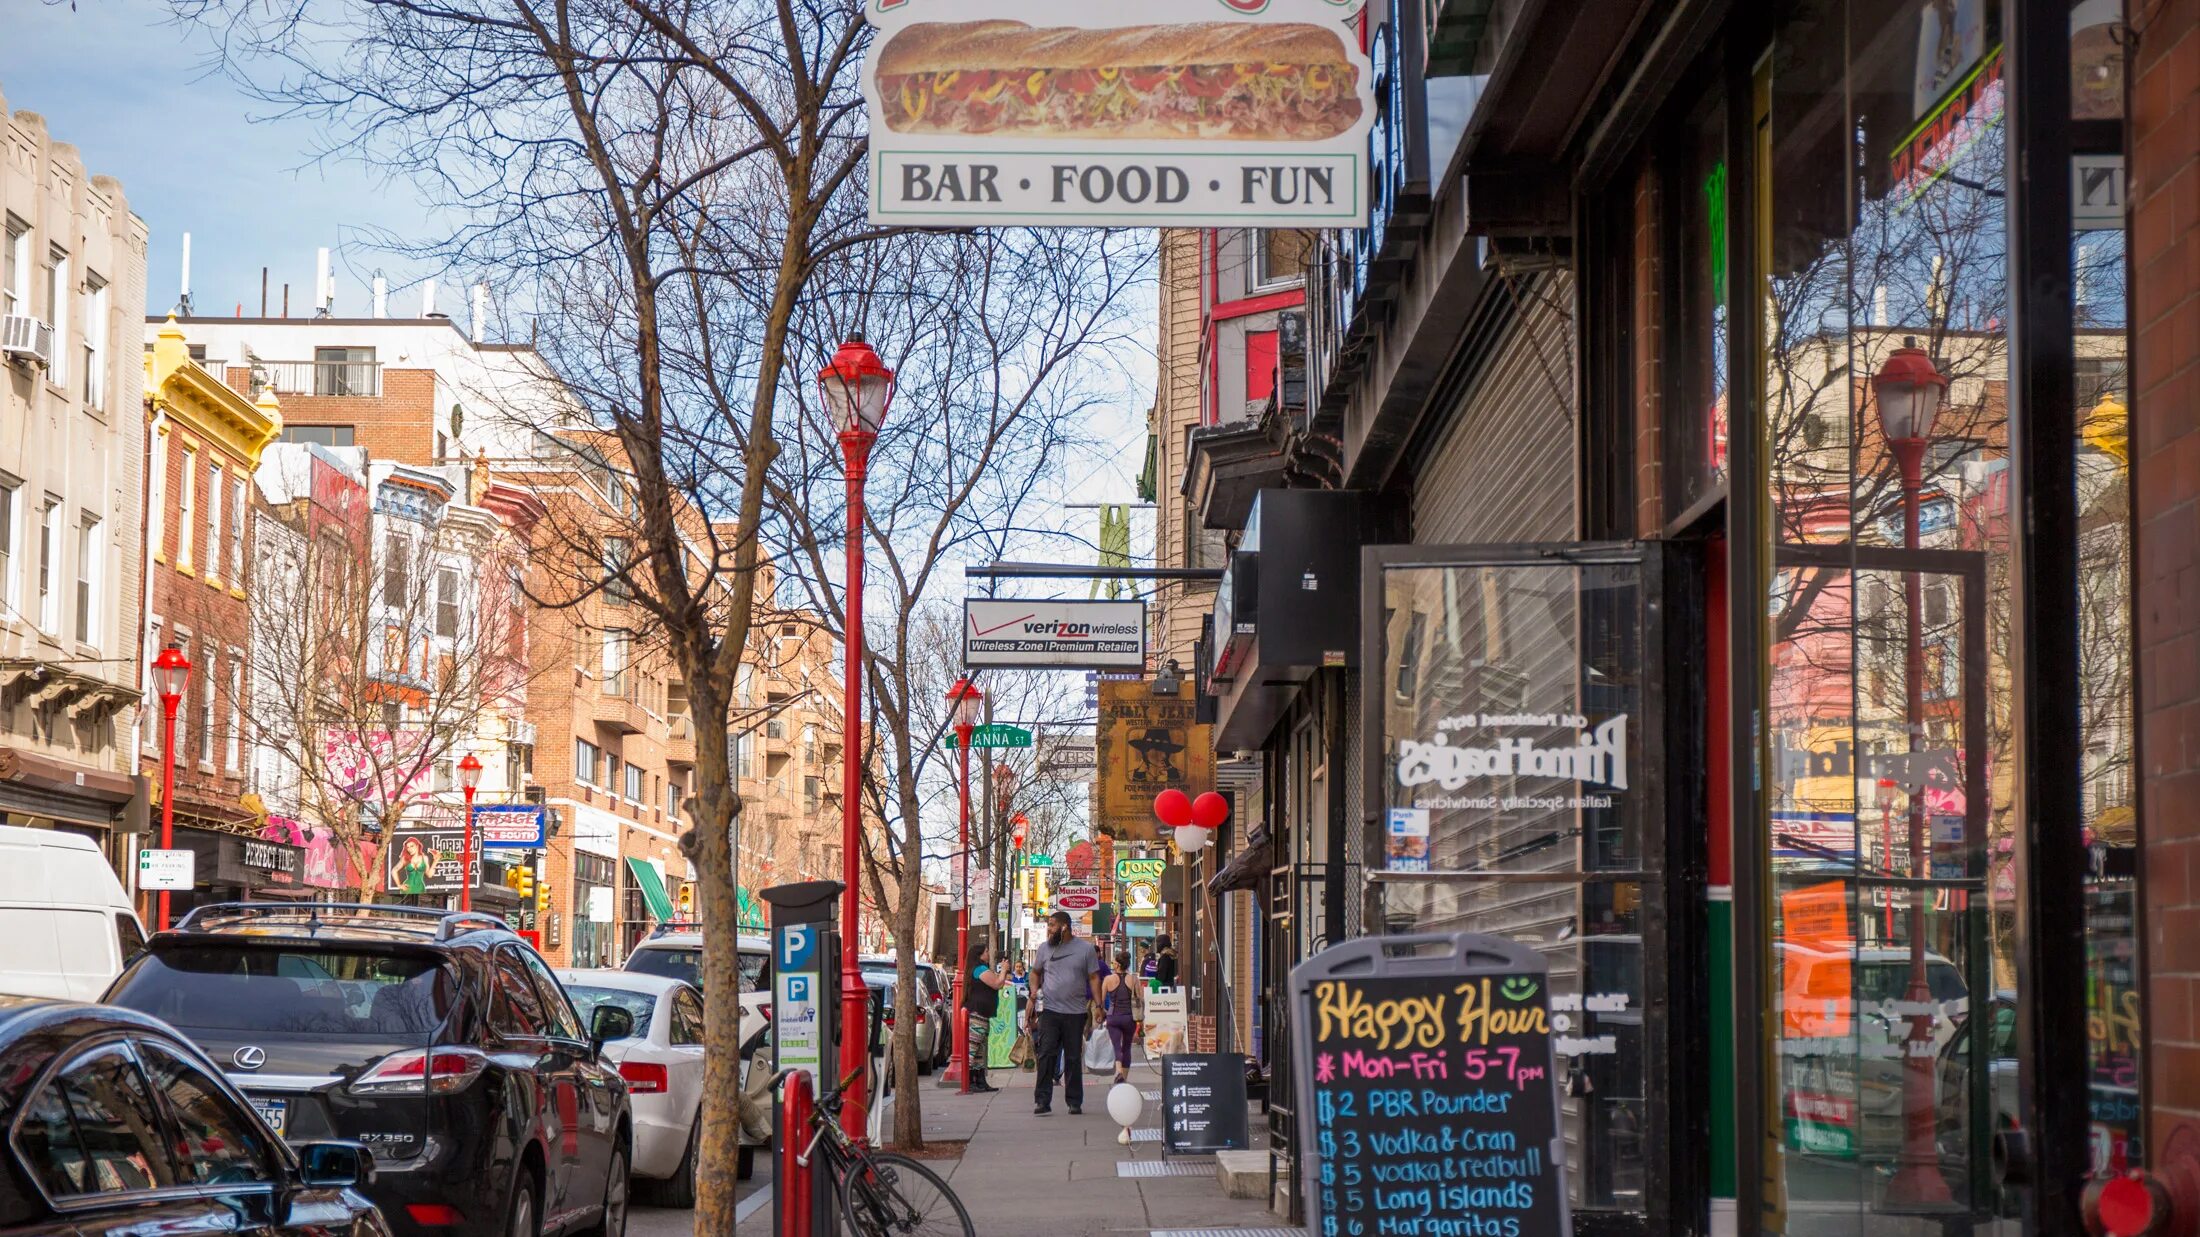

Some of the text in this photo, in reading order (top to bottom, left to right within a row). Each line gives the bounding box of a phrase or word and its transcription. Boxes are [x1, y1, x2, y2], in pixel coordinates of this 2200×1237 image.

[900, 163, 1335, 205] BAR FOOD FUN
[1024, 619, 1138, 637] verizon wireless
[971, 641, 1015, 651] Wireless
[1096, 641, 1138, 652] Retailer
[1125, 719, 1152, 727] WESTERN
[1015, 736, 1024, 745] ST
[499, 831, 536, 839] SOUTH
[245, 842, 277, 869] PERFECT
[277, 848, 295, 872] TIME
[784, 929, 807, 964] P
[790, 980, 805, 999] P
[1314, 978, 1549, 1051] Happy Hour
[1341, 1048, 1449, 1080] Mon-Fri
[1172, 1084, 1187, 1097] #1
[1172, 1101, 1187, 1114] #1
[1367, 1090, 1419, 1118] PBR
[1421, 1089, 1512, 1115] Pounder
[1173, 1119, 1188, 1132] #1
[1373, 1187, 1432, 1217] Long
[1377, 1212, 1521, 1237] Margaritas
